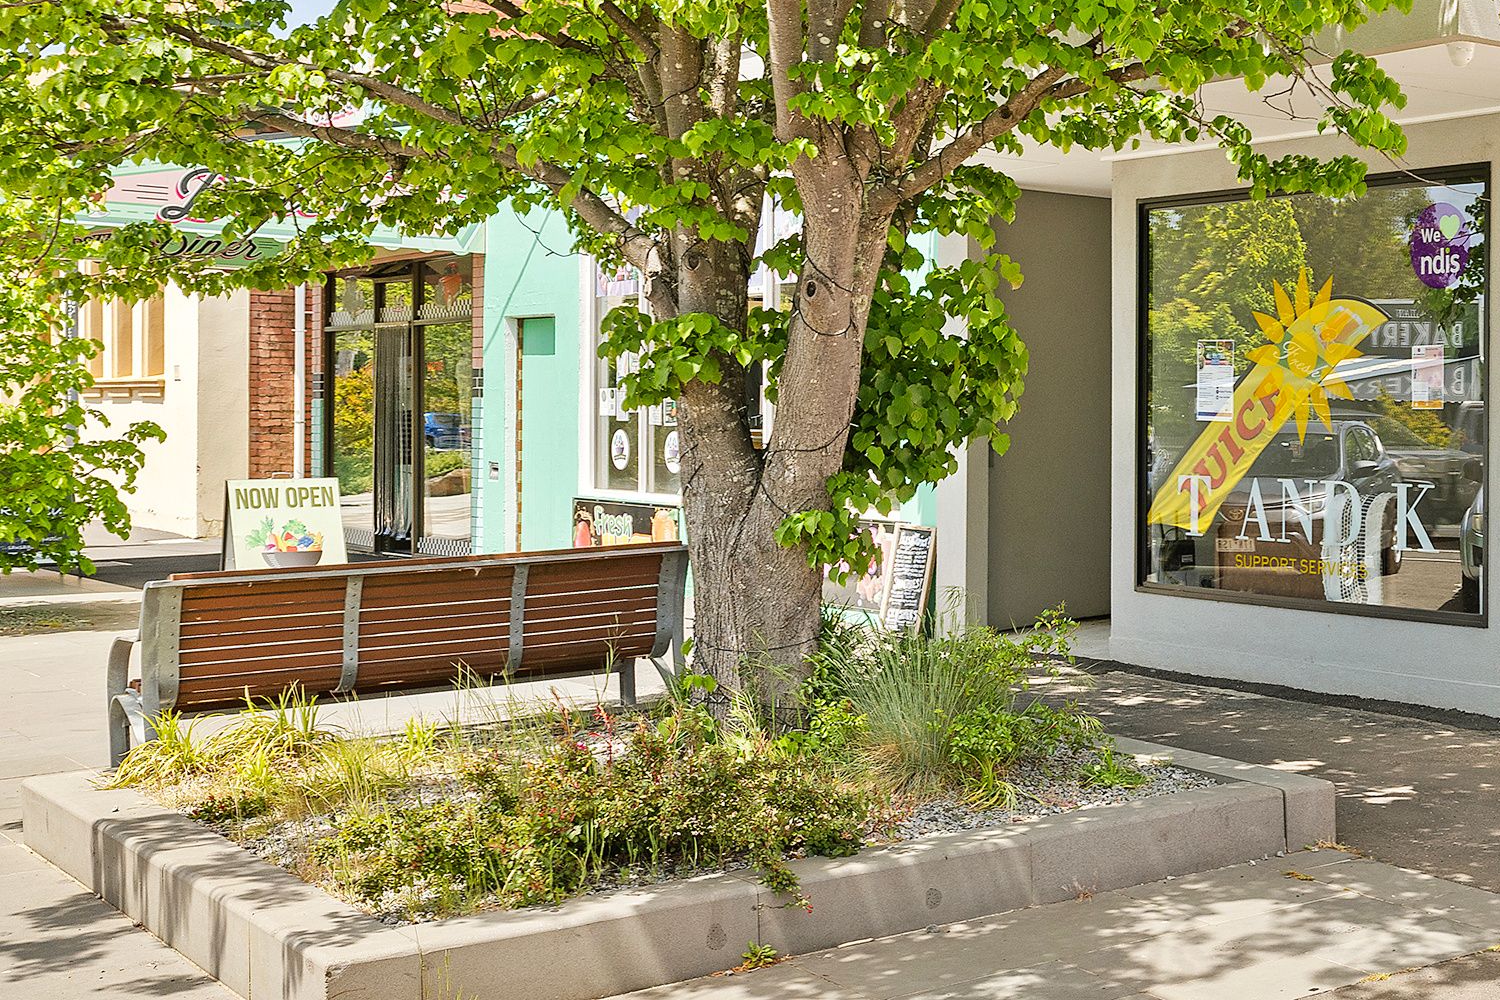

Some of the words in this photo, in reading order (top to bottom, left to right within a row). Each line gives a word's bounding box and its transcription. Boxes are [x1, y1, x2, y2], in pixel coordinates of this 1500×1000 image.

[158, 234, 263, 260] Diner
[1421, 228, 1441, 243] We
[1420, 247, 1461, 275] ndis
[235, 487, 280, 510] NOW
[285, 486, 335, 508] OPEN
[593, 504, 634, 537] fresh
[1177, 474, 1212, 538] T
[1235, 477, 1362, 547] AND
[1391, 483, 1440, 554] K
[1234, 554, 1297, 573] SUPPORT
[1300, 559, 1370, 580] SERVICES
